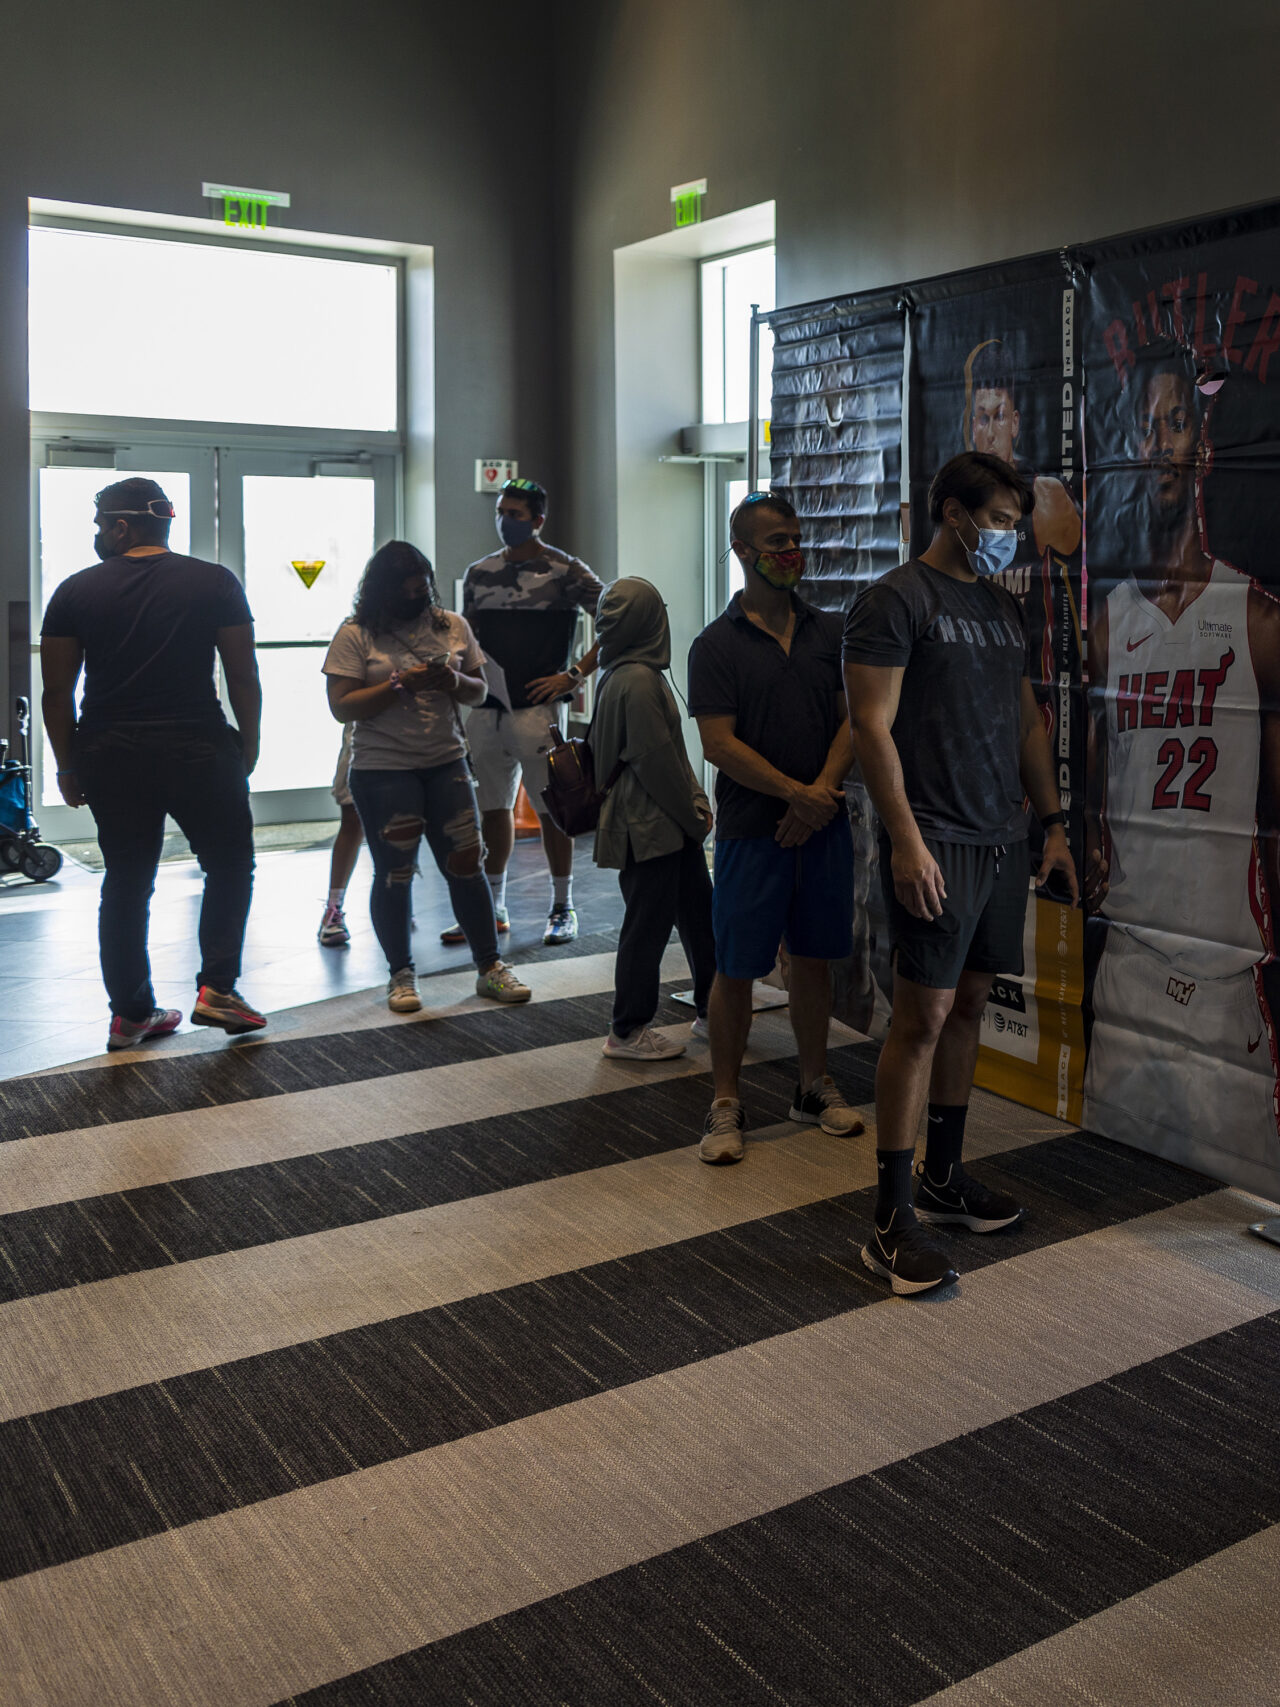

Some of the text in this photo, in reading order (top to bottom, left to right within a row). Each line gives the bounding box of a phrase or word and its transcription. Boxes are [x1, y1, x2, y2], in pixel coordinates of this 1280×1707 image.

[223, 195, 268, 230] EXIT
[1061, 382, 1074, 488] NITED
[1197, 619, 1233, 633] Ultimate
[1199, 631, 1232, 639] SOFTWARE
[1062, 677, 1070, 728] BLACK
[1116, 646, 1236, 733] HEAT
[1152, 736, 1218, 812] 22
[1006, 1019, 1029, 1038] AT&T
